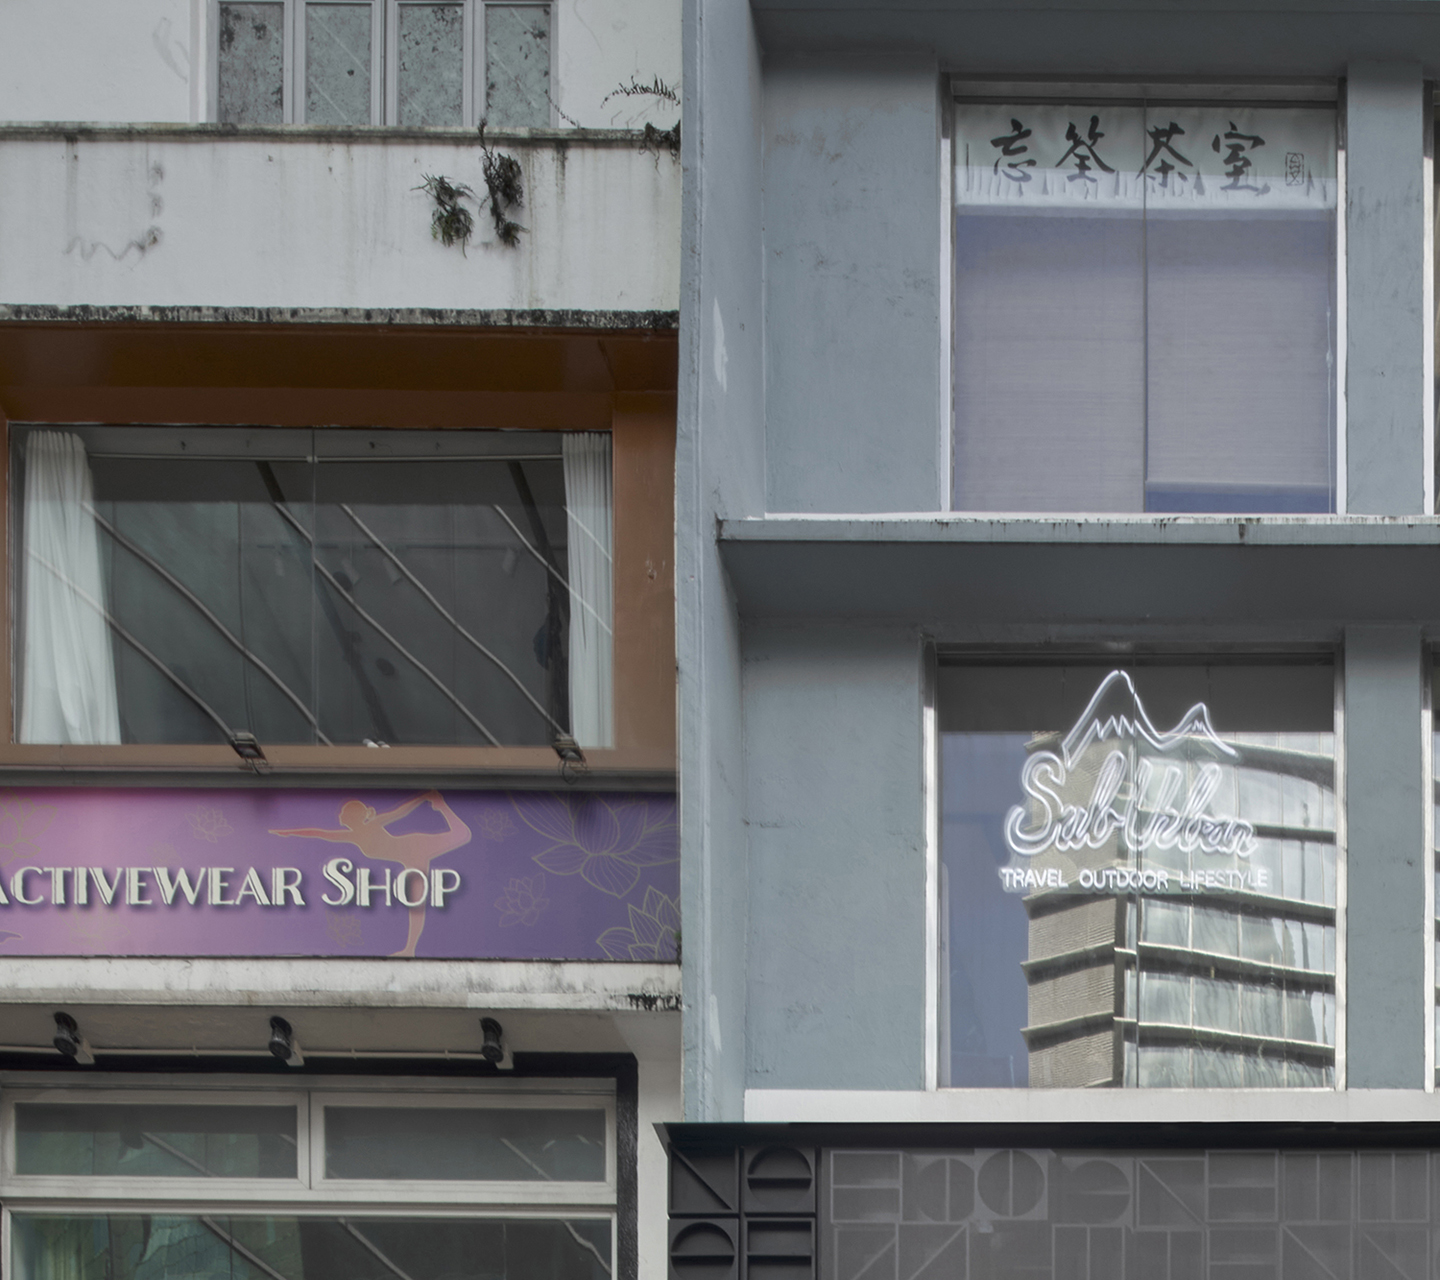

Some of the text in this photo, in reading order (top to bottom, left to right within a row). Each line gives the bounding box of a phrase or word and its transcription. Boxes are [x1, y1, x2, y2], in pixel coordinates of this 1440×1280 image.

[1001, 868, 1268, 891] TRAVEL OUTDOOR LIFESTYLE
